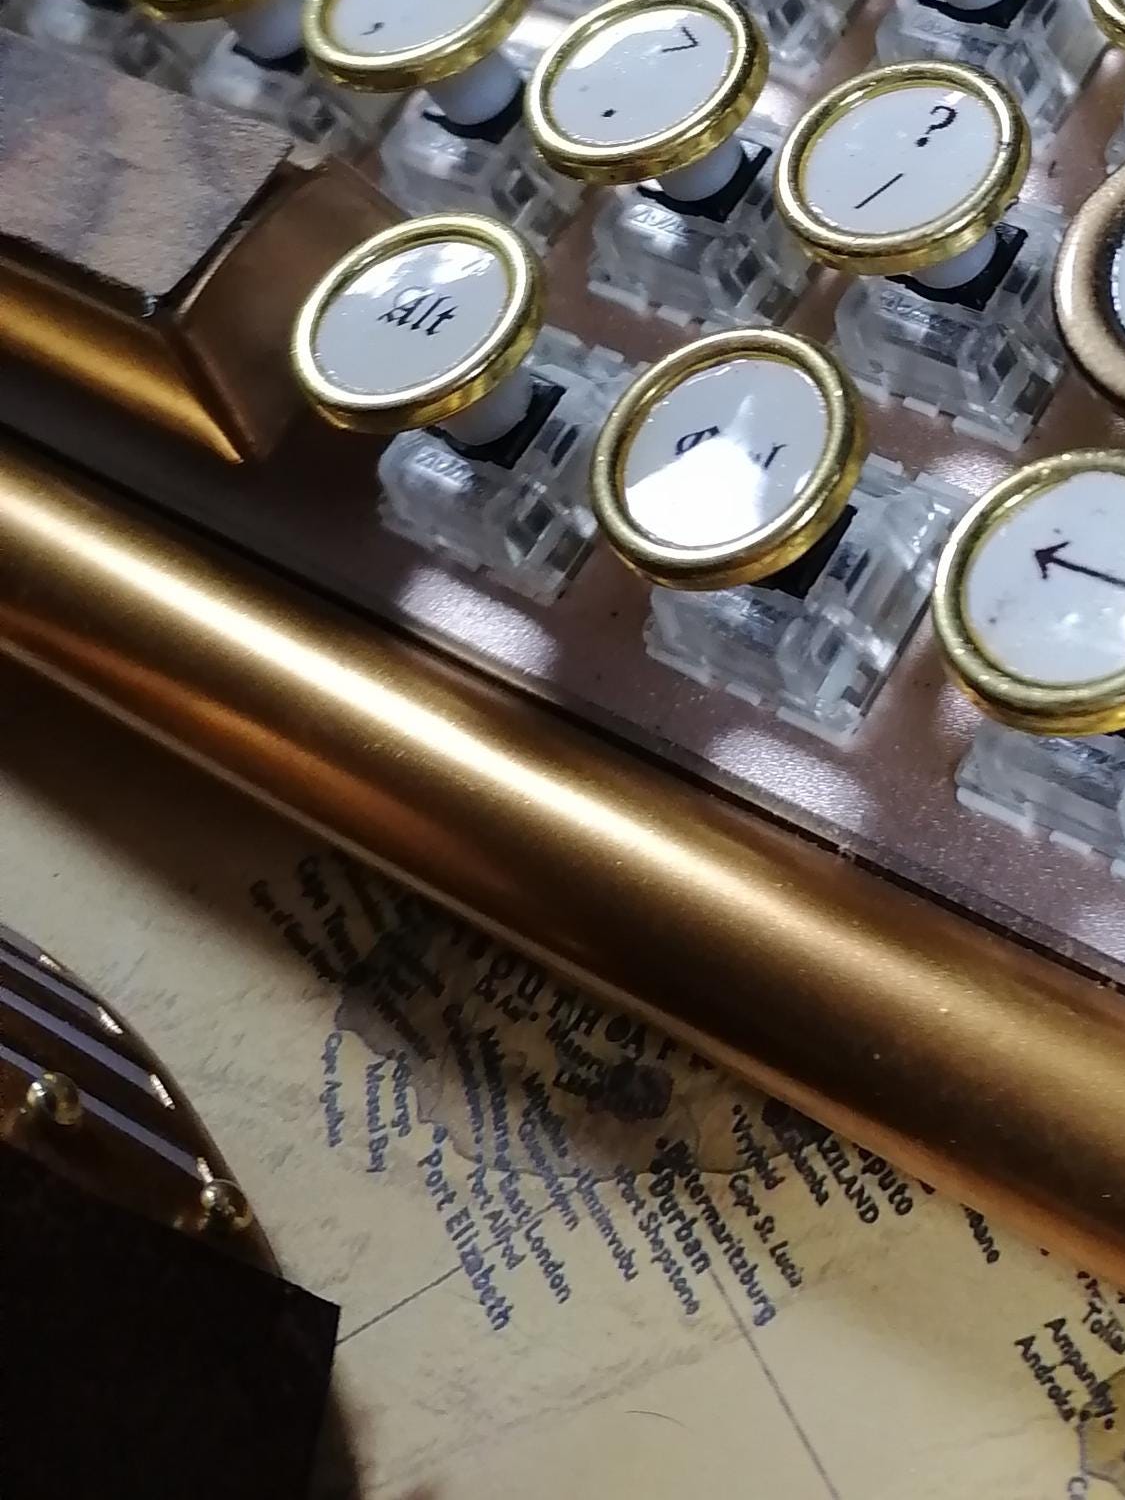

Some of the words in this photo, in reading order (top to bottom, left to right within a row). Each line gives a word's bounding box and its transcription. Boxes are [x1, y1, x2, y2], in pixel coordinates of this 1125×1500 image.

[376, 286, 459, 337] Alt
[417, 1148, 457, 1212] Port
[446, 1206, 515, 1331] Elizabeth
[524, 1218, 572, 1305] London
[615, 1168, 646, 1217] Port
[638, 1211, 700, 1316] Shepstone
[648, 1167, 711, 1275] Durban
